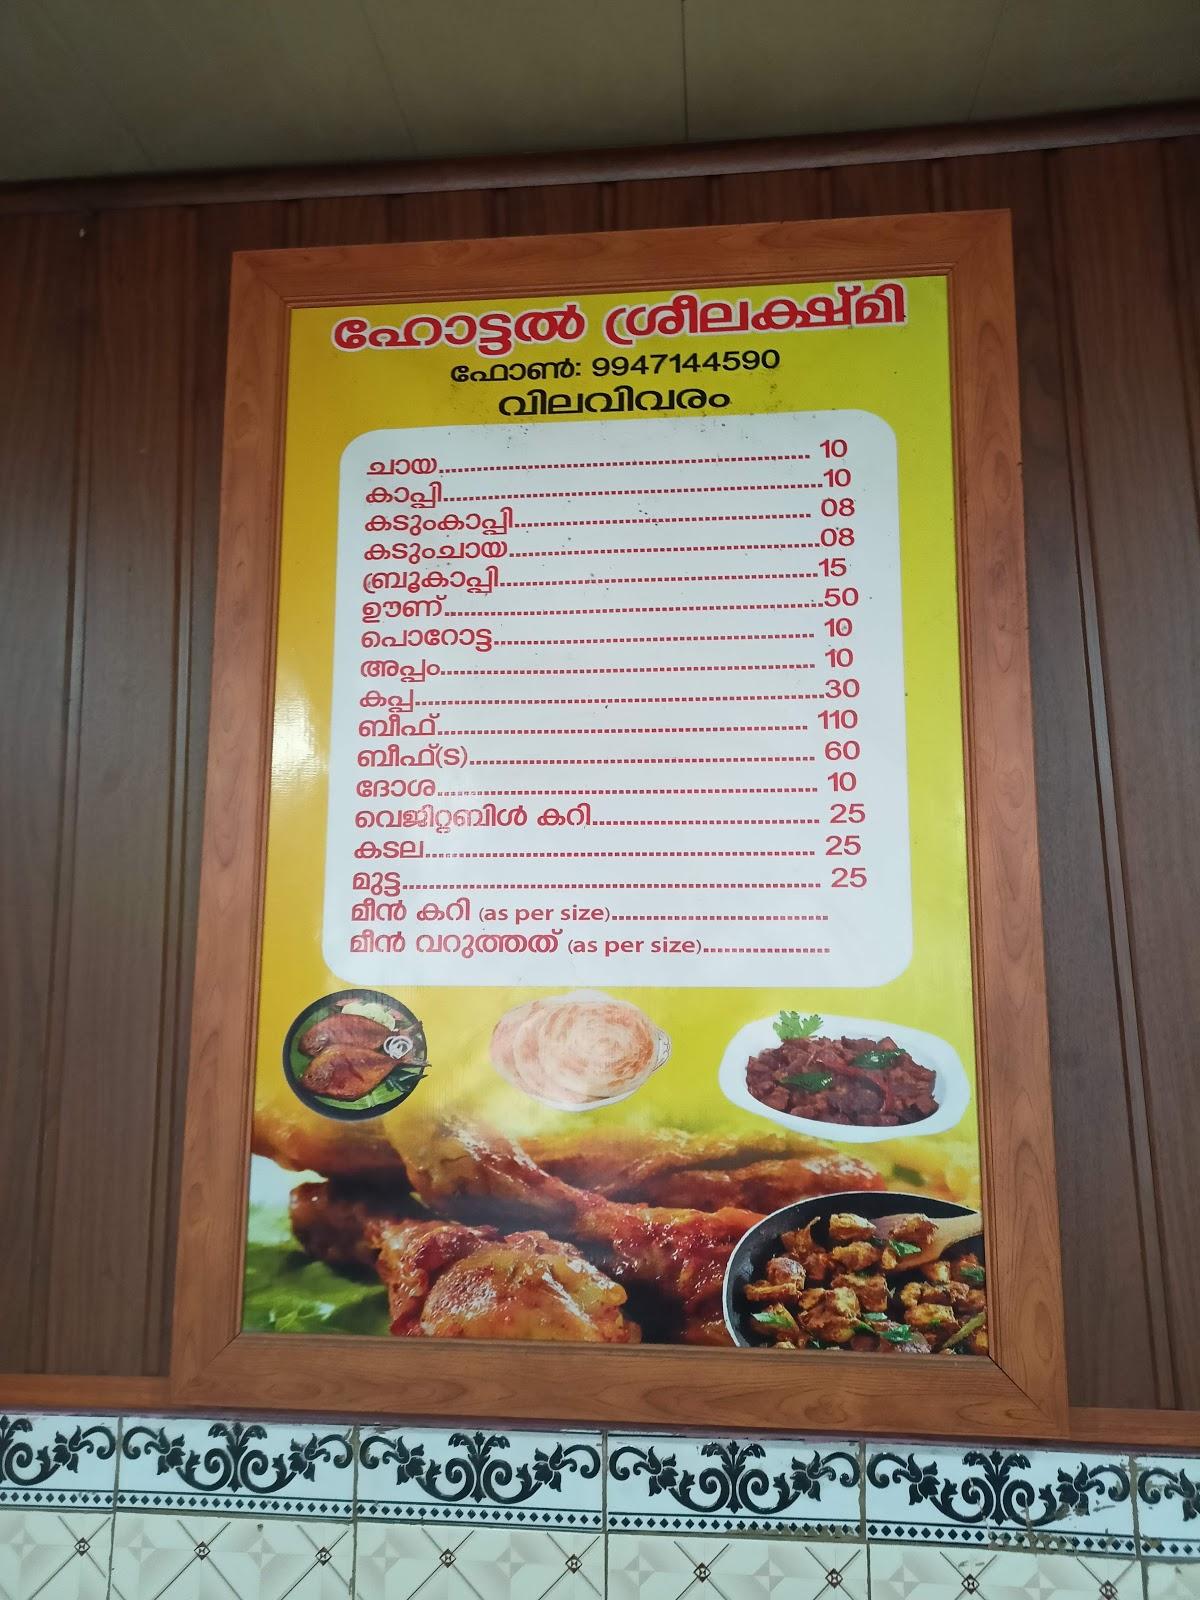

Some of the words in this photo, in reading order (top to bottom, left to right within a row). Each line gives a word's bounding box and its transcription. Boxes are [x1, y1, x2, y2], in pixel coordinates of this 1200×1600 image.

[333, 303, 586, 356] ഹോട്ടൽ
[604, 282, 907, 345] ശ്രീലക്ഷ്മി
[450, 357, 583, 383] ഫോൺ:
[591, 349, 781, 377] 9947144590
[498, 385, 732, 416] വിലവിവരം
[367, 457, 438, 476] ചായ
[820, 439, 848, 458] 10
[365, 481, 442, 509] കാപ്പി
[823, 468, 851, 488] 10
[364, 506, 513, 536] കടുംകാപ്പി
[820, 497, 855, 517] 08
[363, 540, 508, 563] കടുംചായ
[820, 527, 855, 547] 08
[819, 557, 847, 577] 15
[362, 594, 447, 623] ഊണ്
[824, 587, 859, 608] 50
[360, 627, 494, 652] പൊറോട്ട
[824, 617, 853, 638] 10
[360, 658, 440, 683] അപ്പം
[825, 648, 854, 668] 10
[359, 689, 415, 713] കപ്പ
[824, 678, 860, 699] 30
[359, 711, 453, 737] ബീഫ്
[817, 710, 858, 729] 110
[357, 743, 468, 769] ബീഫ്(ട)
[825, 740, 860, 761] 60
[356, 778, 436, 798] ദോശ
[827, 772, 857, 793] 10
[537, 802, 591, 828] കറി
[830, 803, 866, 824] 25
[353, 838, 425, 860] കടല
[825, 835, 862, 856] 25
[352, 871, 402, 897] മുട്ട
[831, 867, 867, 888] 25
[351, 899, 407, 922] മീൻ
[416, 897, 470, 923] കറി
[478, 905, 509, 923] (as
[514, 905, 554, 924] per
[560, 903, 611, 923] size)
[350, 930, 405, 954] മീൻ
[415, 928, 563, 959] വറുത്തത്
[567, 937, 598, 955] (as
[603, 937, 644, 956] per
[650, 936, 702, 955] size)
